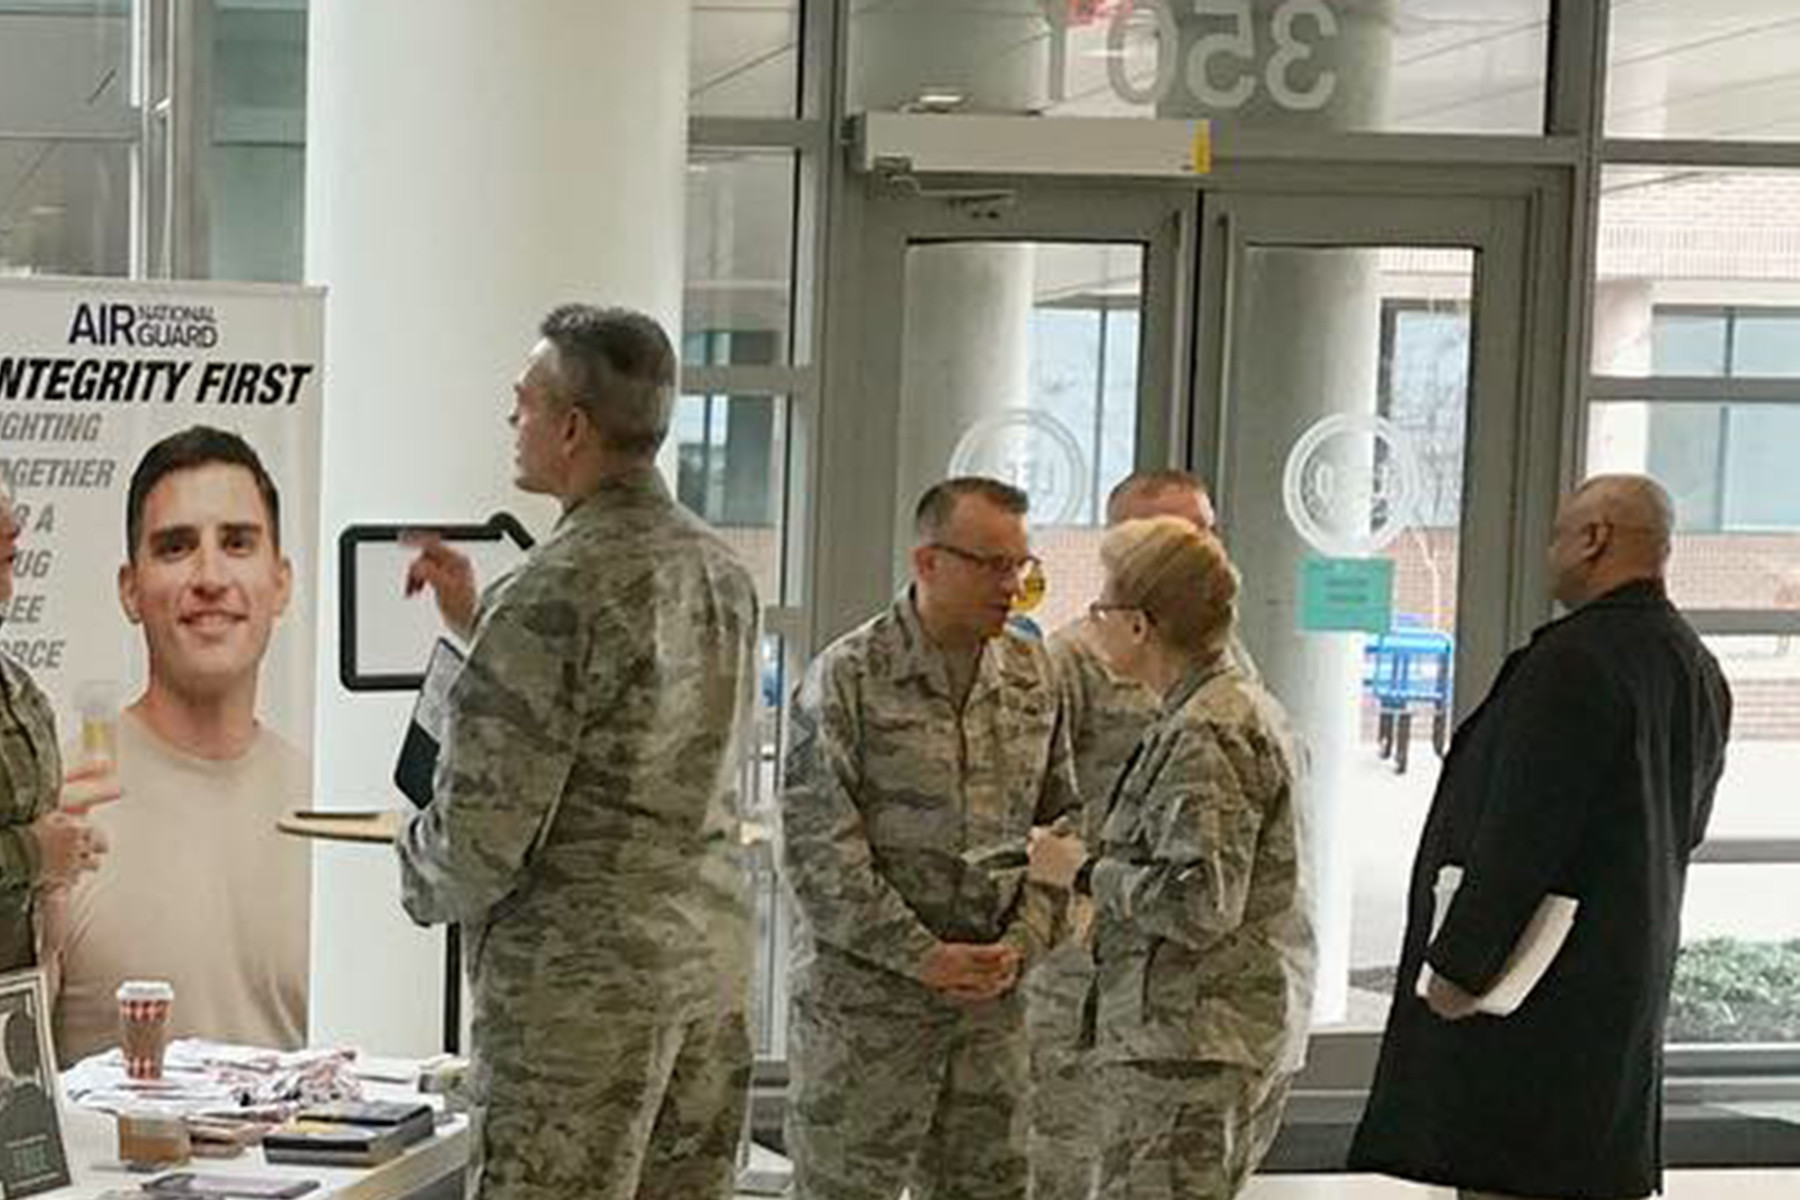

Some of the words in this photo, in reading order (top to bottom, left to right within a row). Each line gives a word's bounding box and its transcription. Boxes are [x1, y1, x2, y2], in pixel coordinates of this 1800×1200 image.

[68, 302, 136, 347] AIR
[137, 305, 217, 323] NATIONAL
[137, 324, 218, 349] GUARD
[195, 362, 314, 405] FIRST
[34, 504, 55, 534] A
[13, 549, 52, 579] UG
[1, 595, 46, 624] EE
